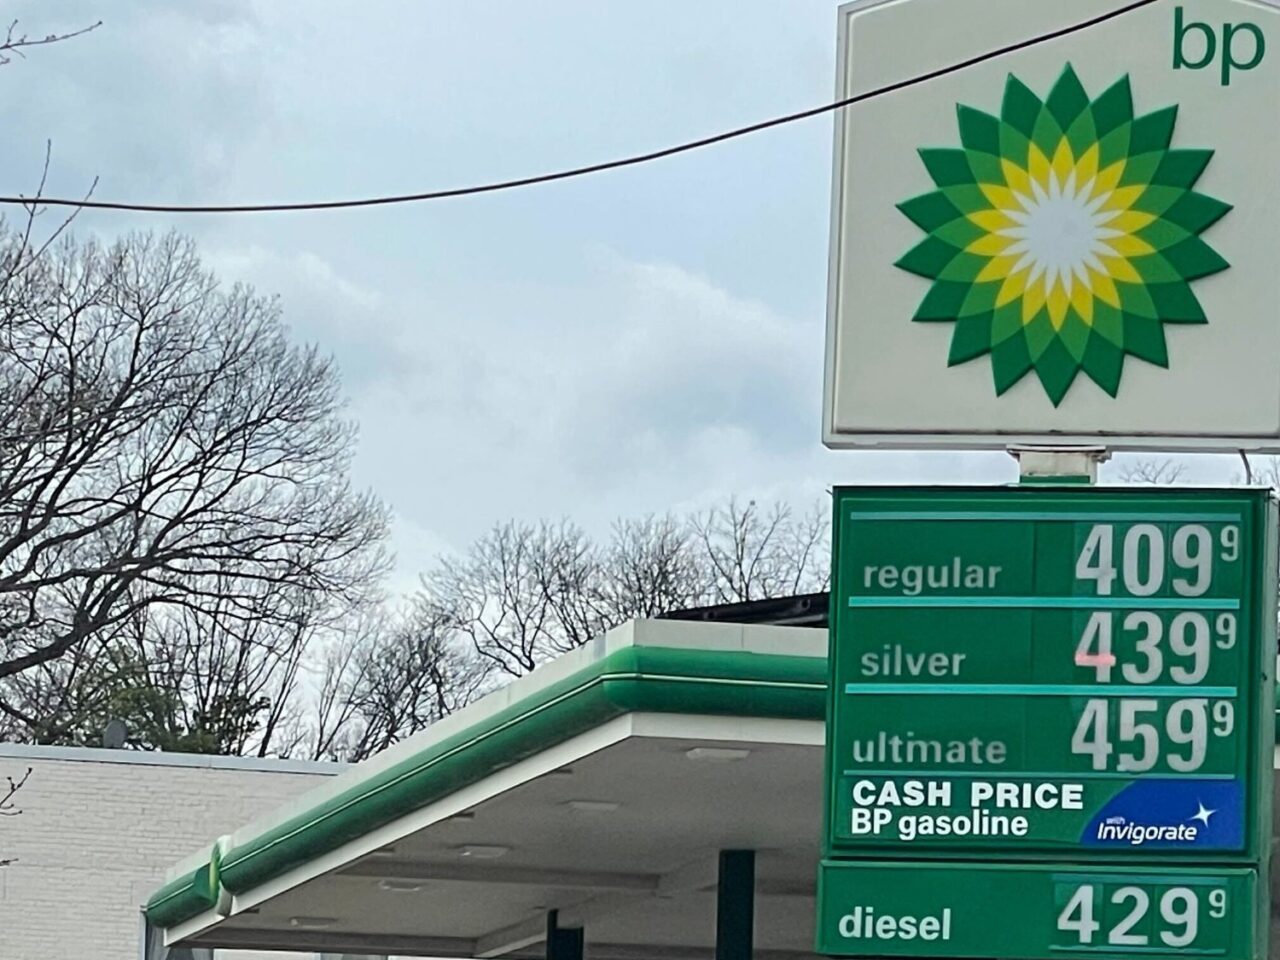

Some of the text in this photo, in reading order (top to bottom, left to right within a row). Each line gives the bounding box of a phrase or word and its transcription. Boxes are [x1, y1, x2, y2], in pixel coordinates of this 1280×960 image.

[1173, 6, 1265, 86] bp
[864, 557, 1002, 595] regular
[860, 645, 966, 677] silver
[853, 731, 1007, 765] ultimate
[853, 780, 1083, 809] CASH PRICE
[852, 808, 1028, 840] BP gasoline
[1097, 822, 1198, 845] Invigorate
[838, 907, 951, 939] diesel
